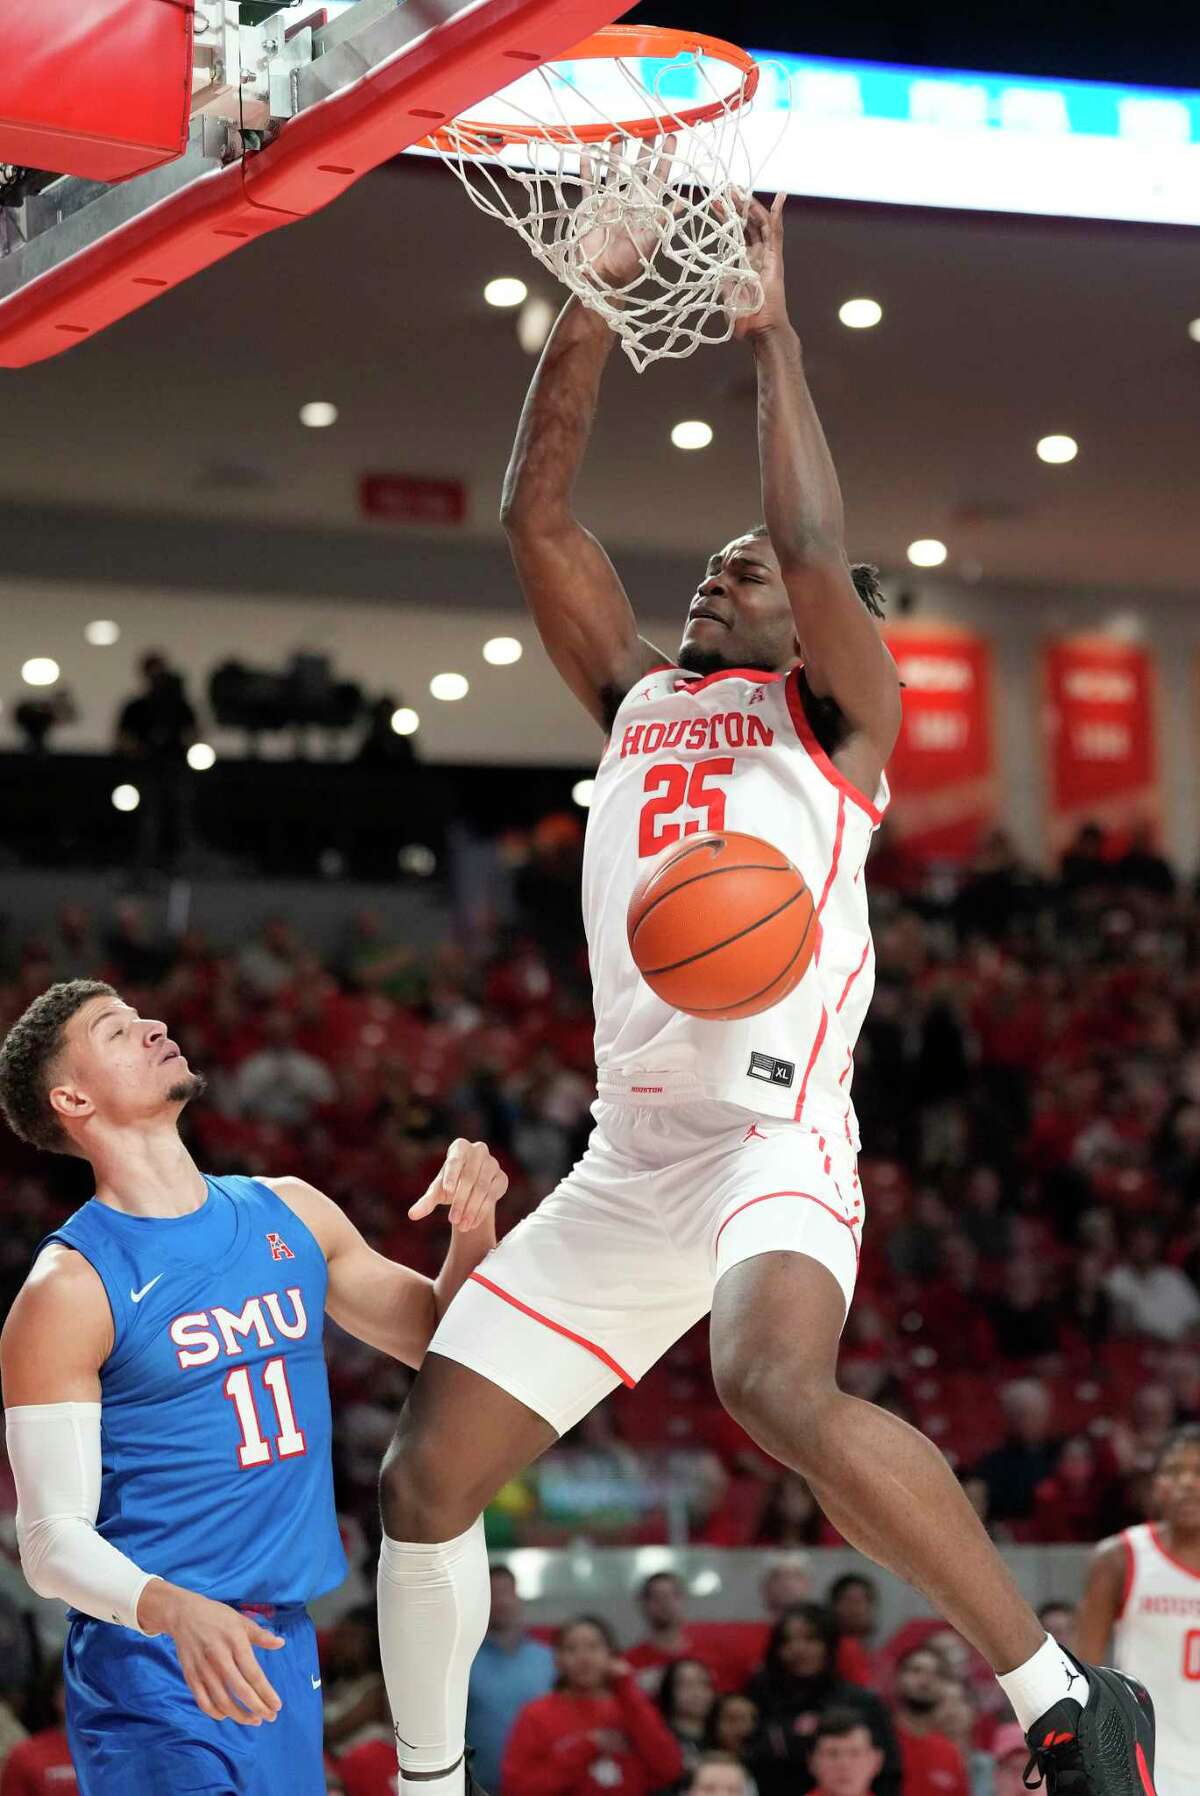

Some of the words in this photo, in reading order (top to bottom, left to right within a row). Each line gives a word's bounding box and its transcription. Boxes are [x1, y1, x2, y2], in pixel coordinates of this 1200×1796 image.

[620, 712, 774, 759] HOUSTON
[638, 757, 735, 858] 25
[775, 1066, 789, 1080] XL
[170, 1288, 308, 1369] SMU
[223, 1356, 307, 1470] 11
